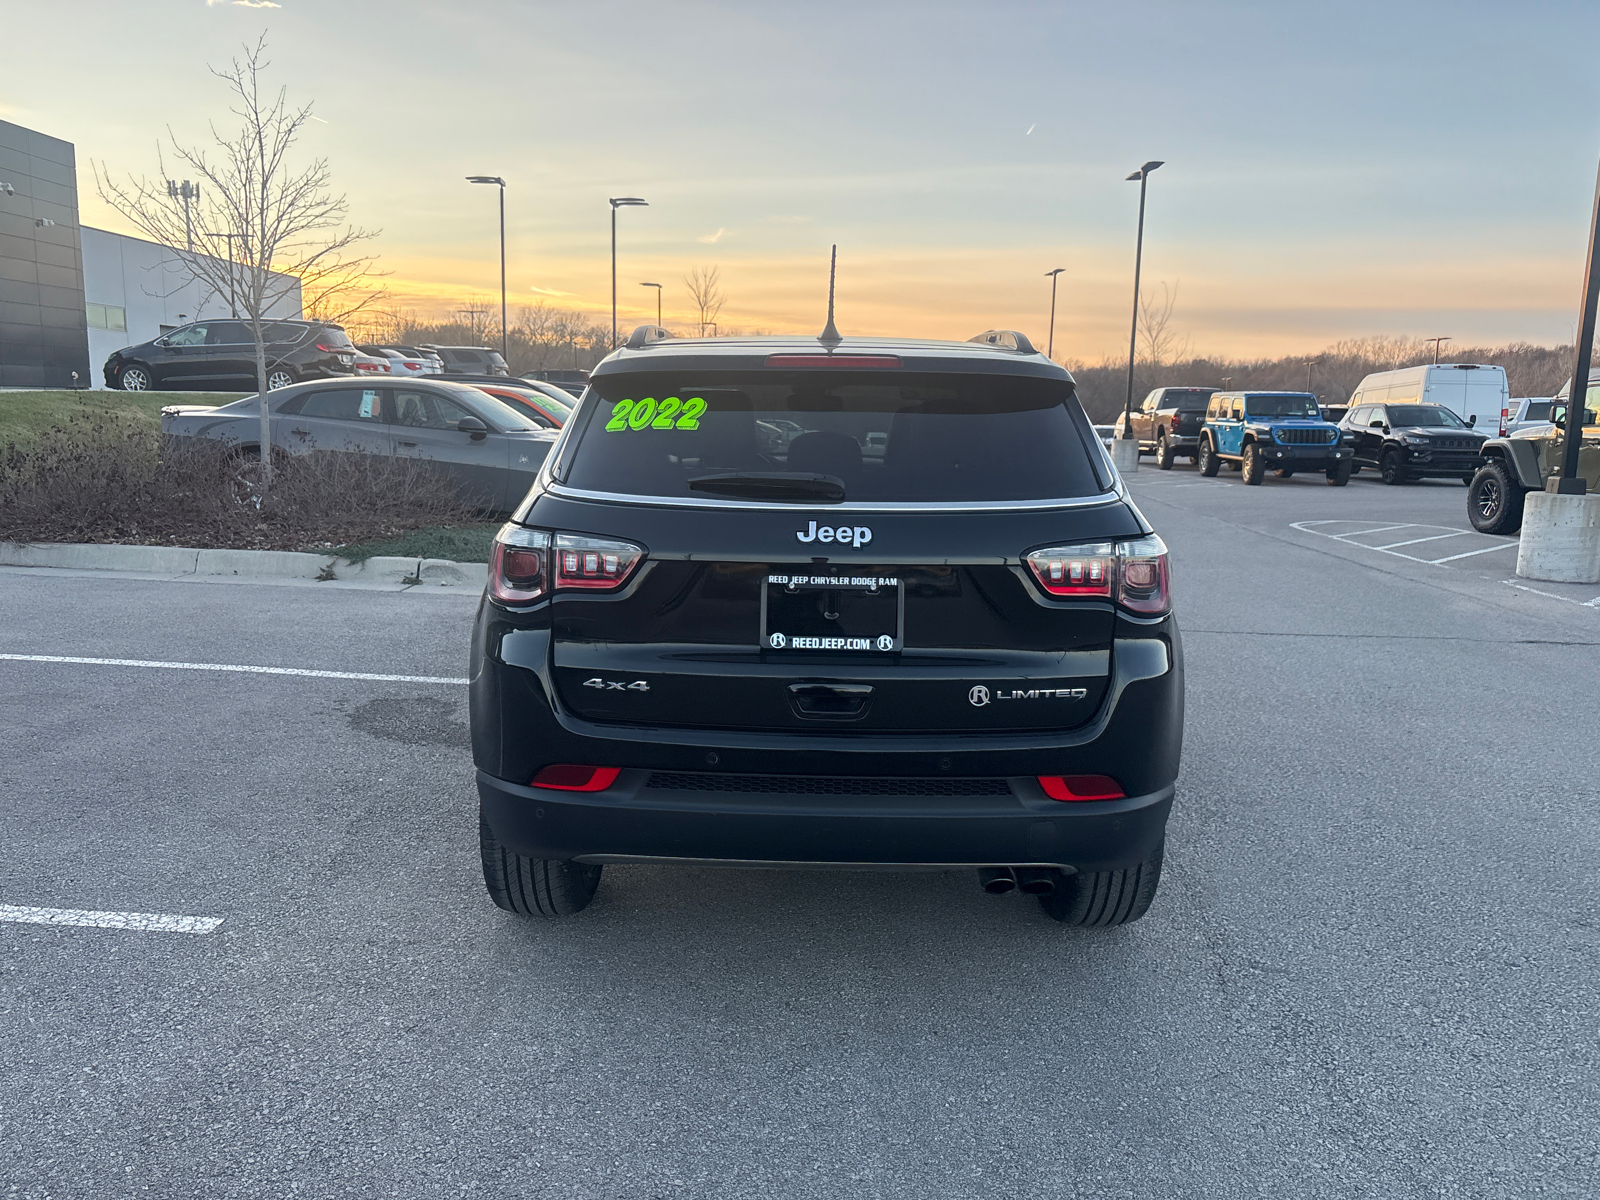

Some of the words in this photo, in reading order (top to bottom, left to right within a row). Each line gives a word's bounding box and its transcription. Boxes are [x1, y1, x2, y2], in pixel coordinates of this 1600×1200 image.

[605, 397, 708, 432] 2022
[797, 520, 872, 548] Jeep
[768, 575, 788, 584] REED
[790, 576, 809, 585] JEEP
[810, 576, 850, 586] CHRYSLER
[851, 577, 877, 587] DODGE
[878, 578, 898, 586] RAM
[770, 632, 786, 649] R
[792, 637, 870, 650] REEDJEEP.COM
[877, 634, 893, 652] R
[582, 677, 650, 692] 4x4
[968, 685, 991, 707] R
[996, 688, 1087, 700] LIMITED
